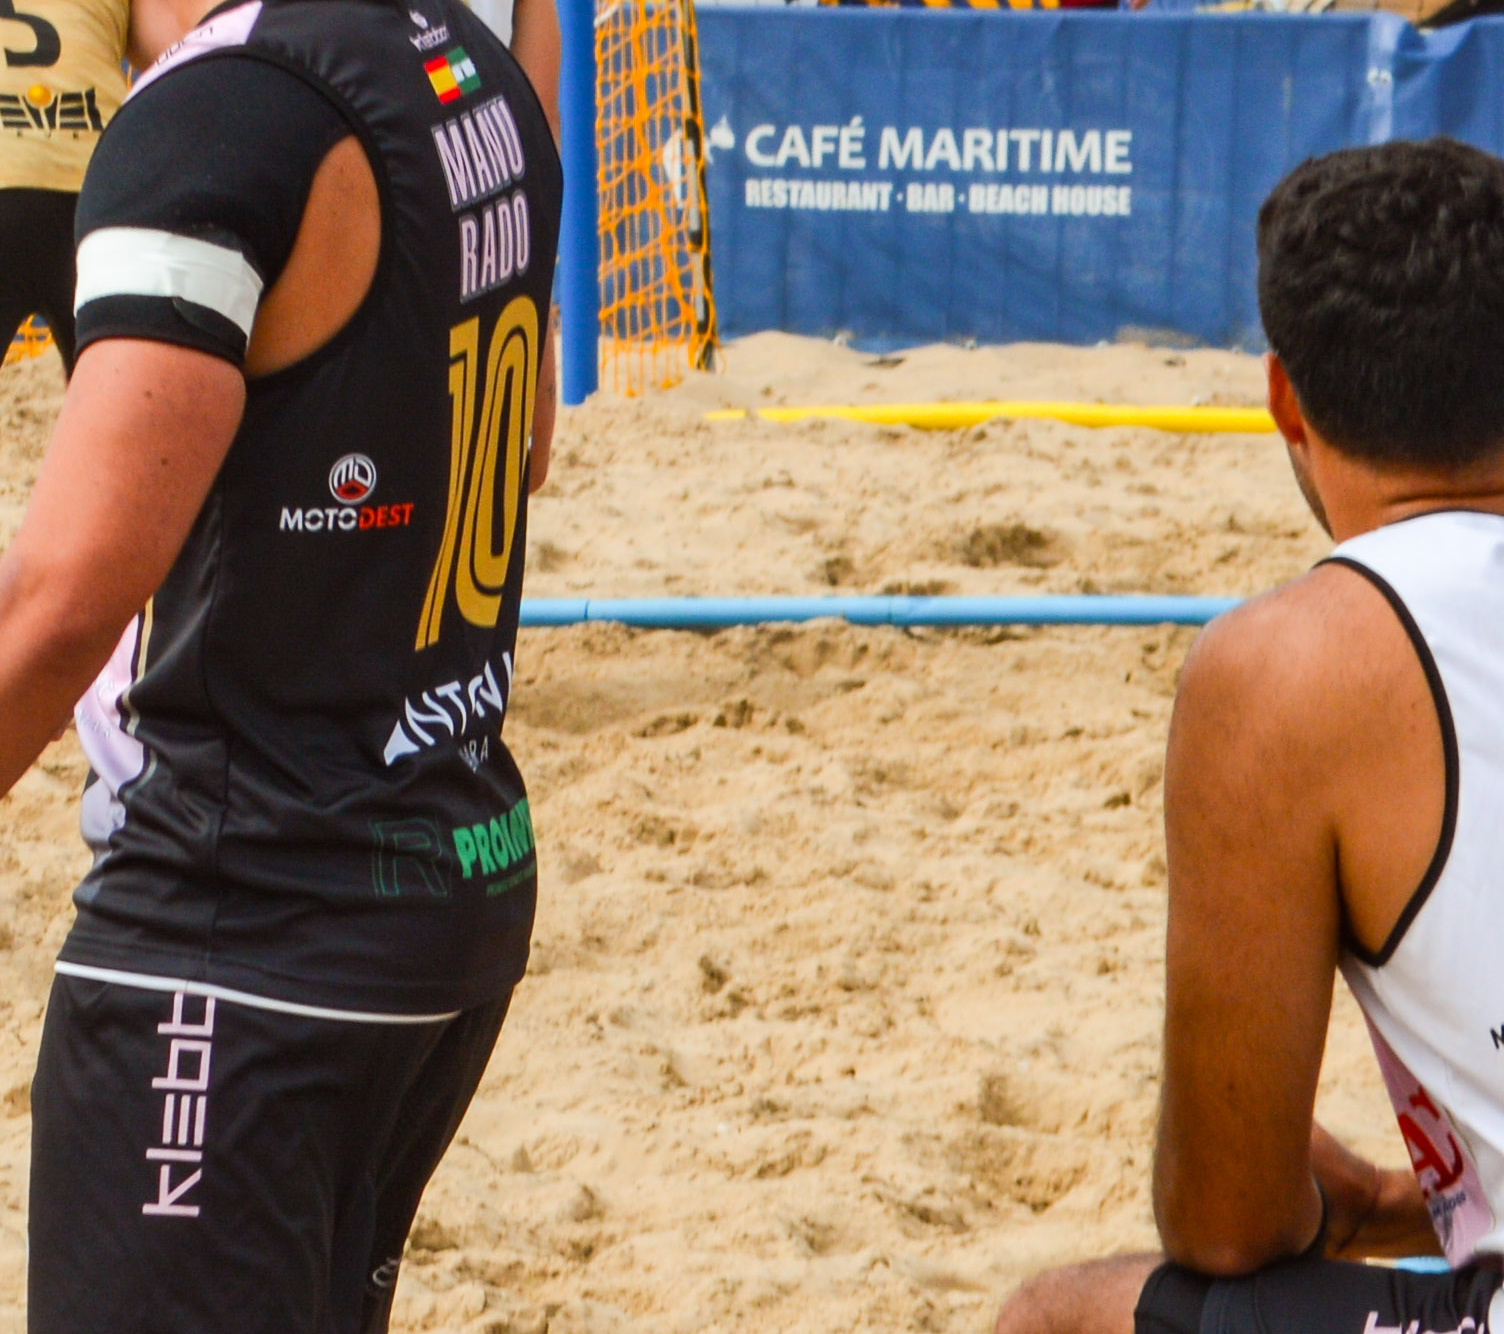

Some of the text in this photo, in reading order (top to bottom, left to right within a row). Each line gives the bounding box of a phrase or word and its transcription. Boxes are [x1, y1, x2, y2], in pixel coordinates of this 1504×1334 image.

[431, 94, 526, 212] MANU
[745, 115, 1133, 174] CAFÉ MARITIME
[745, 179, 1131, 216] RESTAURANT BAR BEACH HOUSE
[415, 296, 539, 652] 10
[279, 501, 414, 532] MOTODEST
